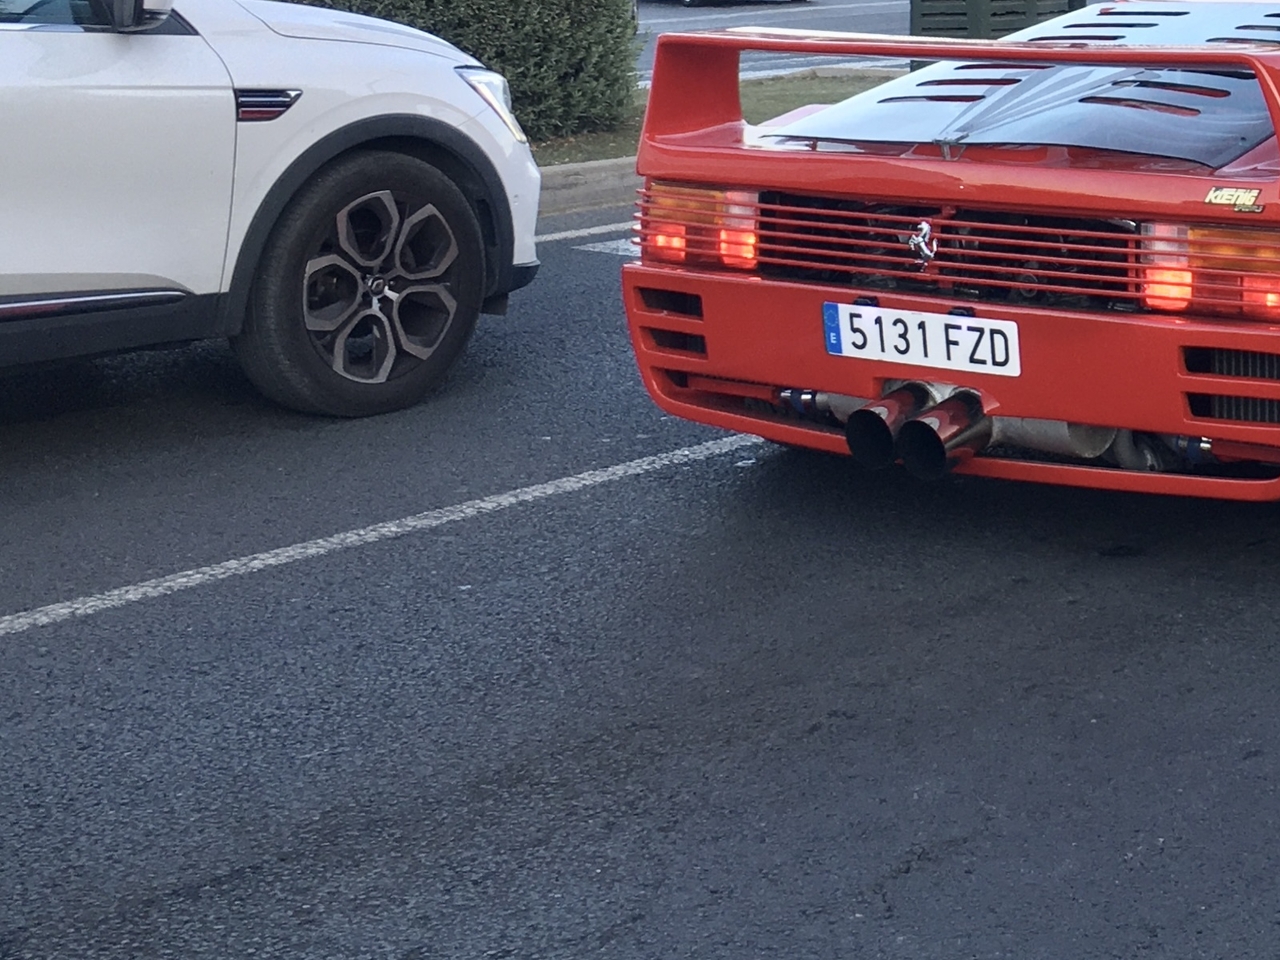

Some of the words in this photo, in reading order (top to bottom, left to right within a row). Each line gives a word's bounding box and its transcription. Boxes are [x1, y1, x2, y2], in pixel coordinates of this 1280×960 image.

[830, 333, 837, 343] E
[849, 312, 929, 358] 5131
[944, 323, 1010, 367] FZD
